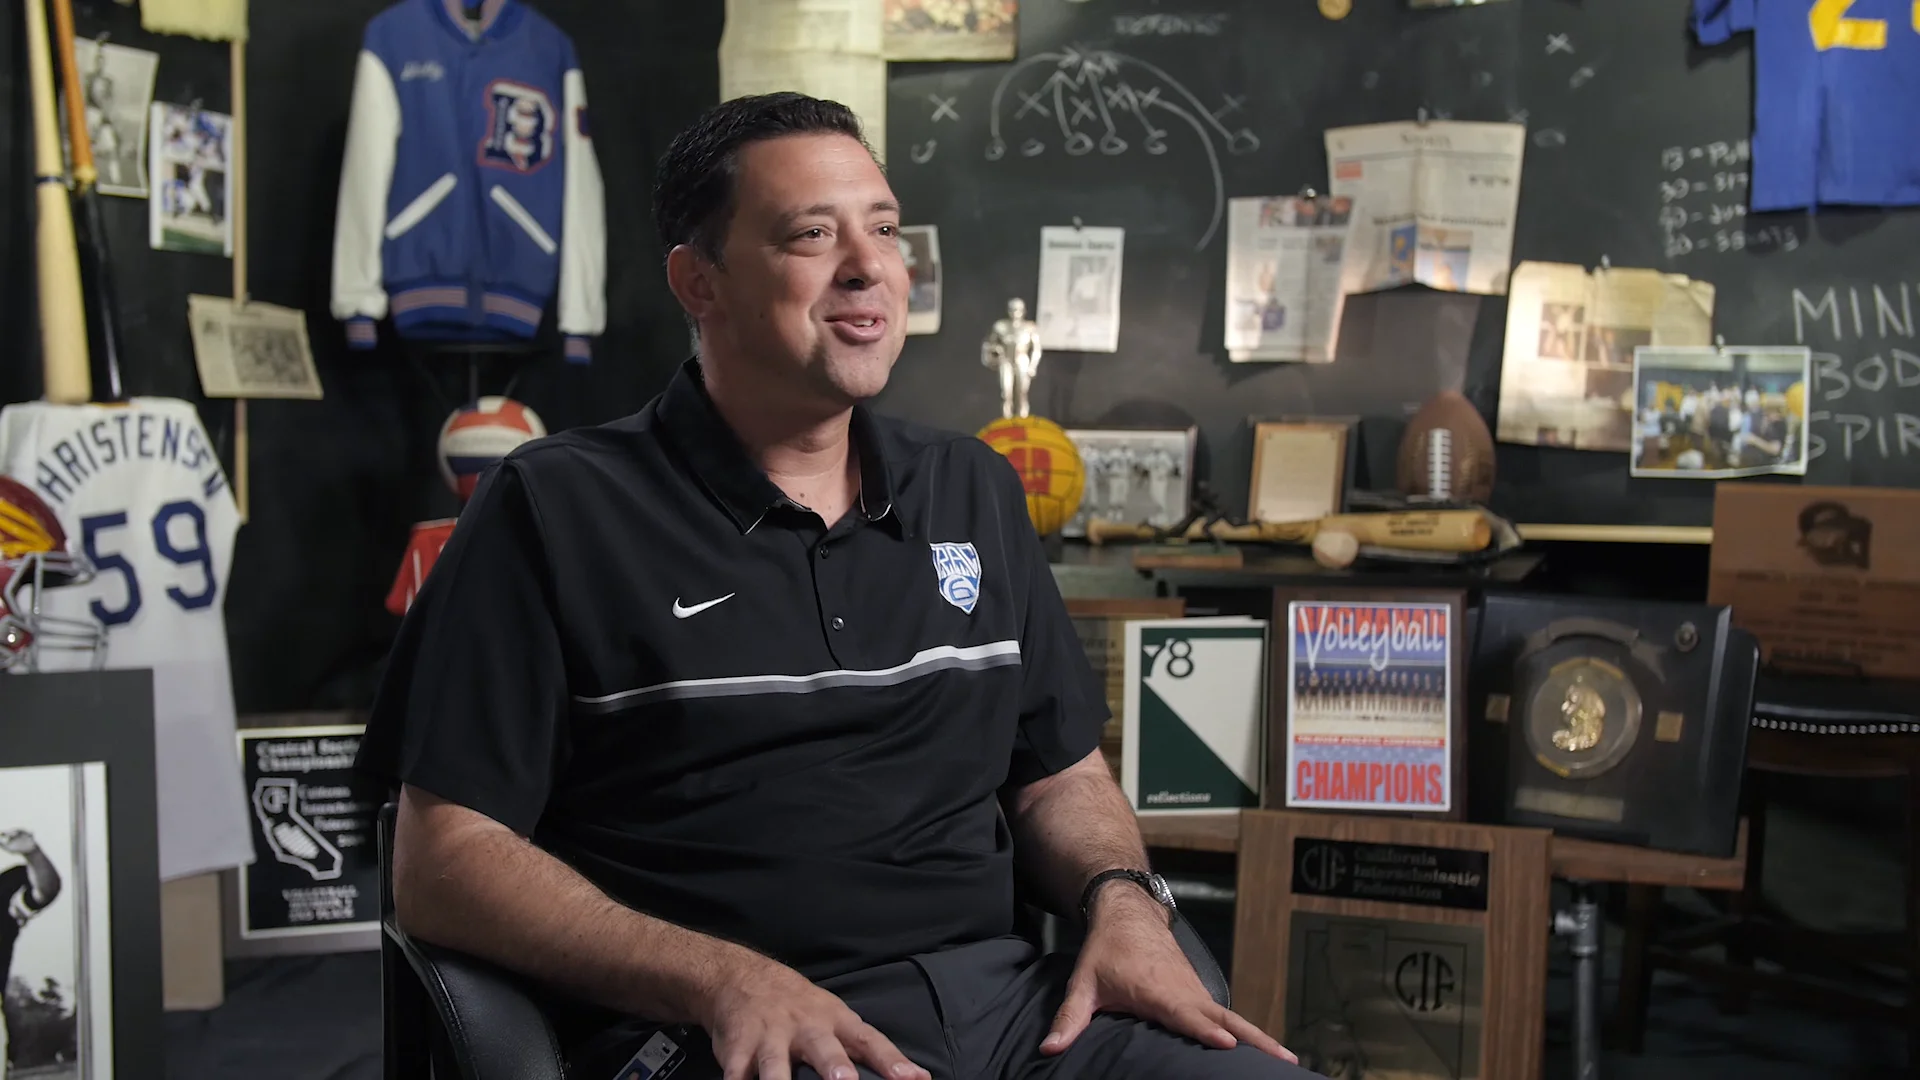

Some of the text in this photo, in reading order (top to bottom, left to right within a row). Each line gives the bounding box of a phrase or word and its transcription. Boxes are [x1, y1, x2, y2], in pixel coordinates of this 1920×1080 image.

[1808, 0, 1920, 52] 2
[1792, 281, 1920, 344] MIN
[80, 499, 218, 628] 59
[1299, 604, 1445, 672] Volleyball
[1296, 759, 1444, 805] CHAMPIONS
[1395, 952, 1455, 1012] CIF
